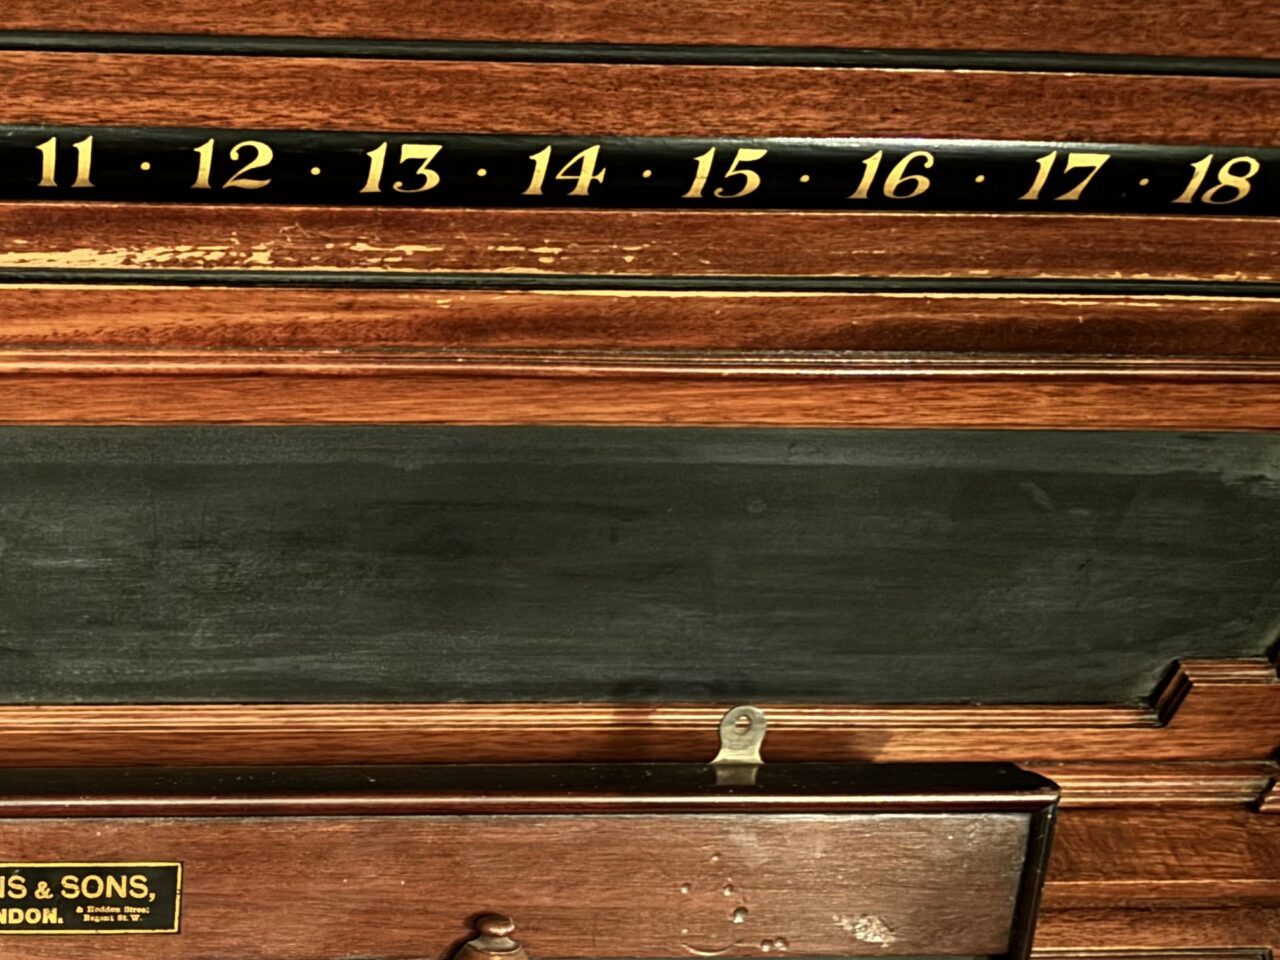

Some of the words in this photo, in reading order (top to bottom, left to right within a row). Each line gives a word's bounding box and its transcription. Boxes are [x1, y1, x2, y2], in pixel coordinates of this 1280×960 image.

[35, 136, 95, 189] 11
[192, 138, 275, 190] 12
[359, 141, 443, 193] 13
[522, 144, 607, 197] 14
[682, 147, 768, 199] 15
[849, 148, 935, 201] 16
[1019, 150, 1112, 202] 17
[1171, 153, 1261, 204] 18
[34, 880, 54, 900] &
[60, 874, 156, 902] SONS,
